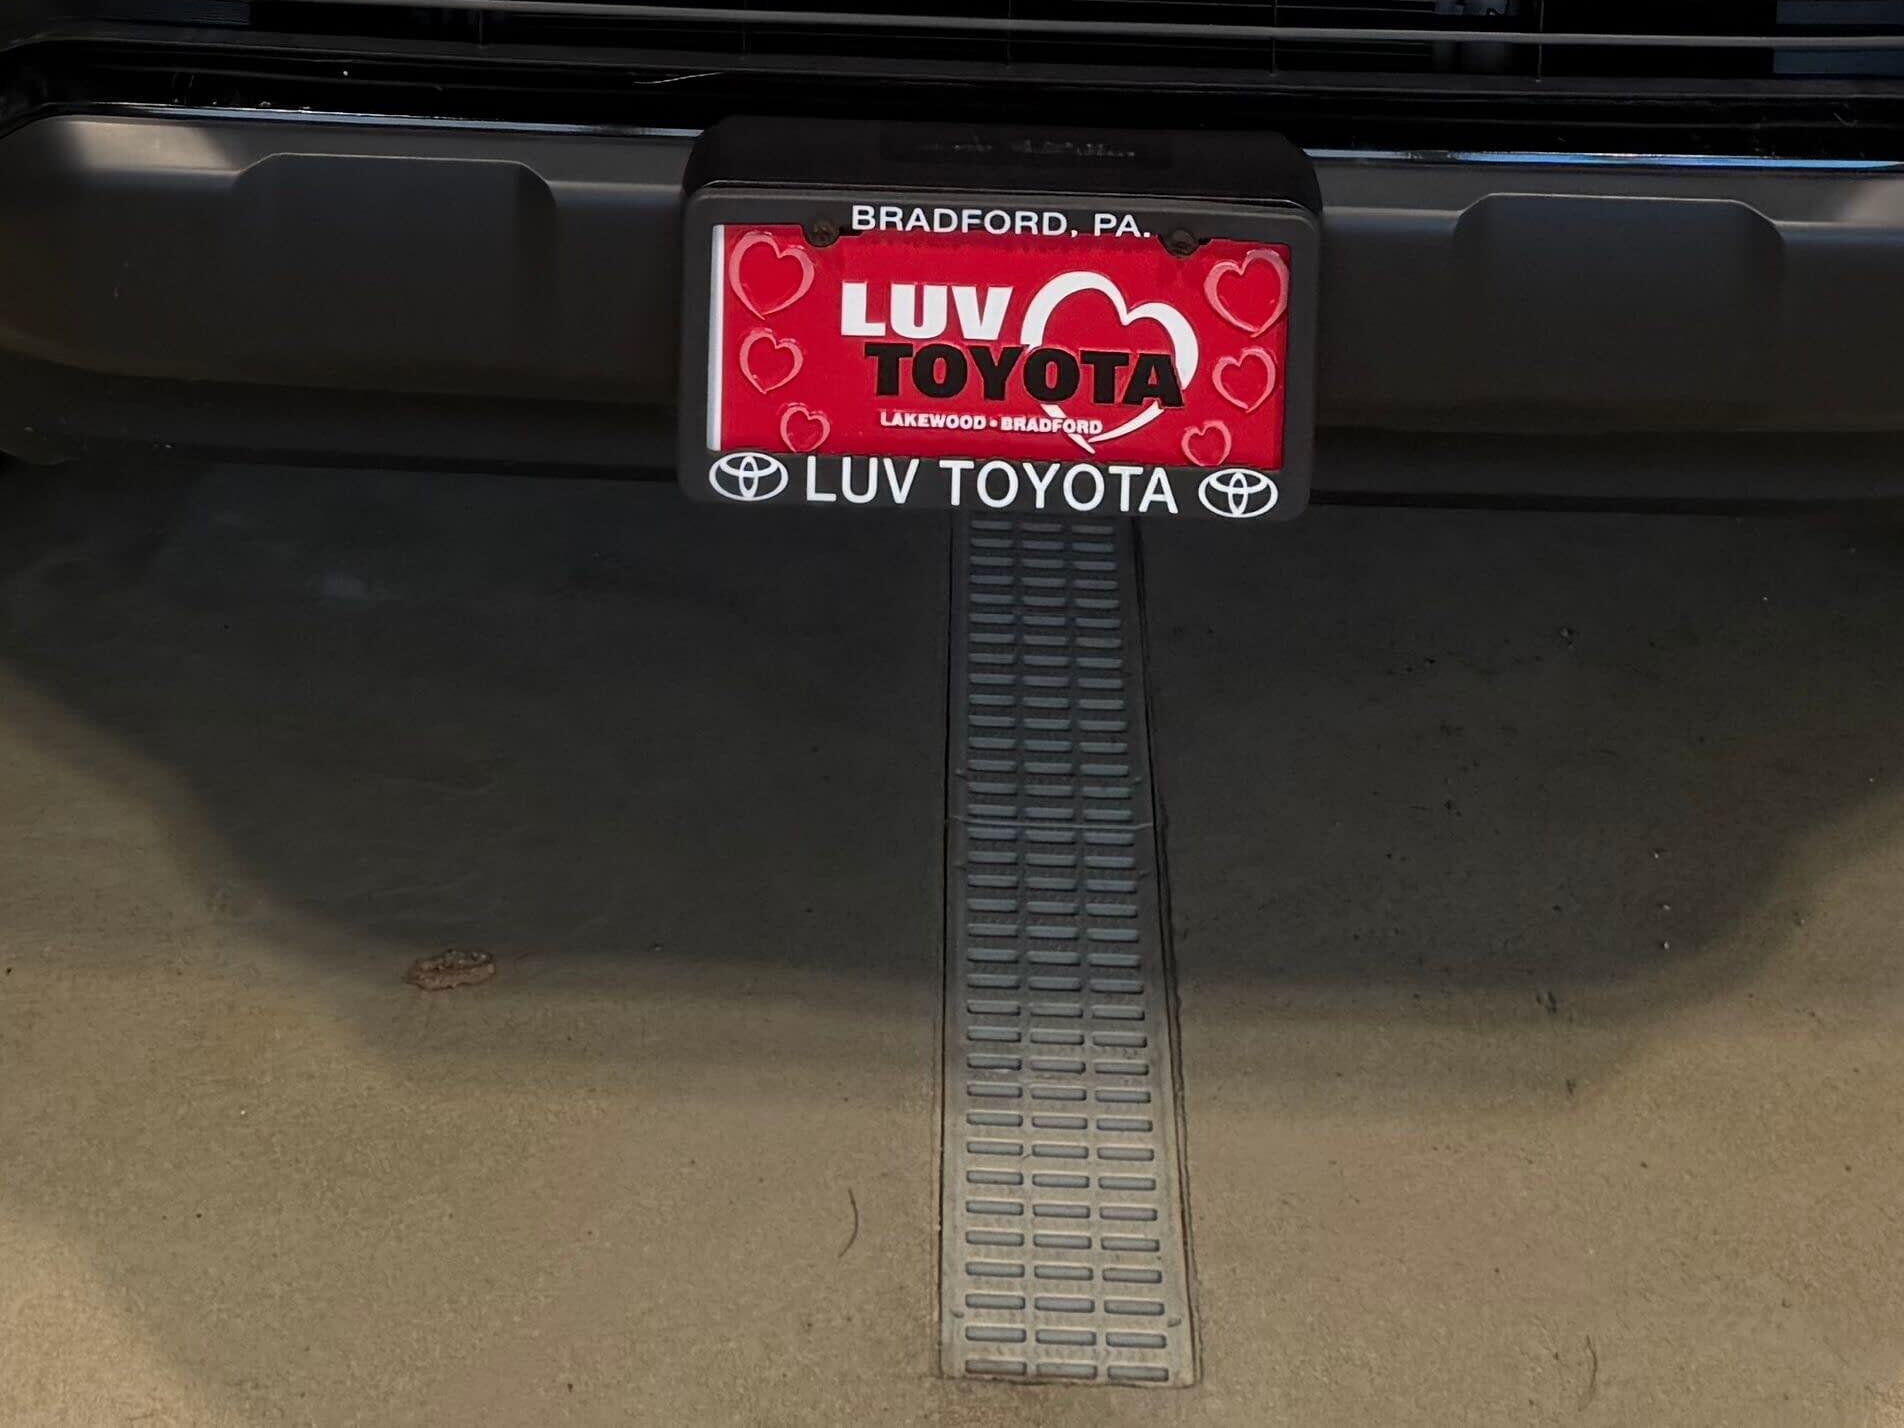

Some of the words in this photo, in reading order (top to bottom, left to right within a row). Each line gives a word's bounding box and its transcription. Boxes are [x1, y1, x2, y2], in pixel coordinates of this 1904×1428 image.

[851, 204, 1079, 239] BRADFORD,
[1093, 212, 1151, 239] PA.
[840, 280, 1014, 341] LUV
[864, 342, 1184, 407] TOYOTA
[880, 410, 987, 431] LAKEWOOD
[1000, 416, 1104, 435] BRADFORD
[805, 455, 921, 505] LUV
[938, 459, 1178, 515] TOYOTA
